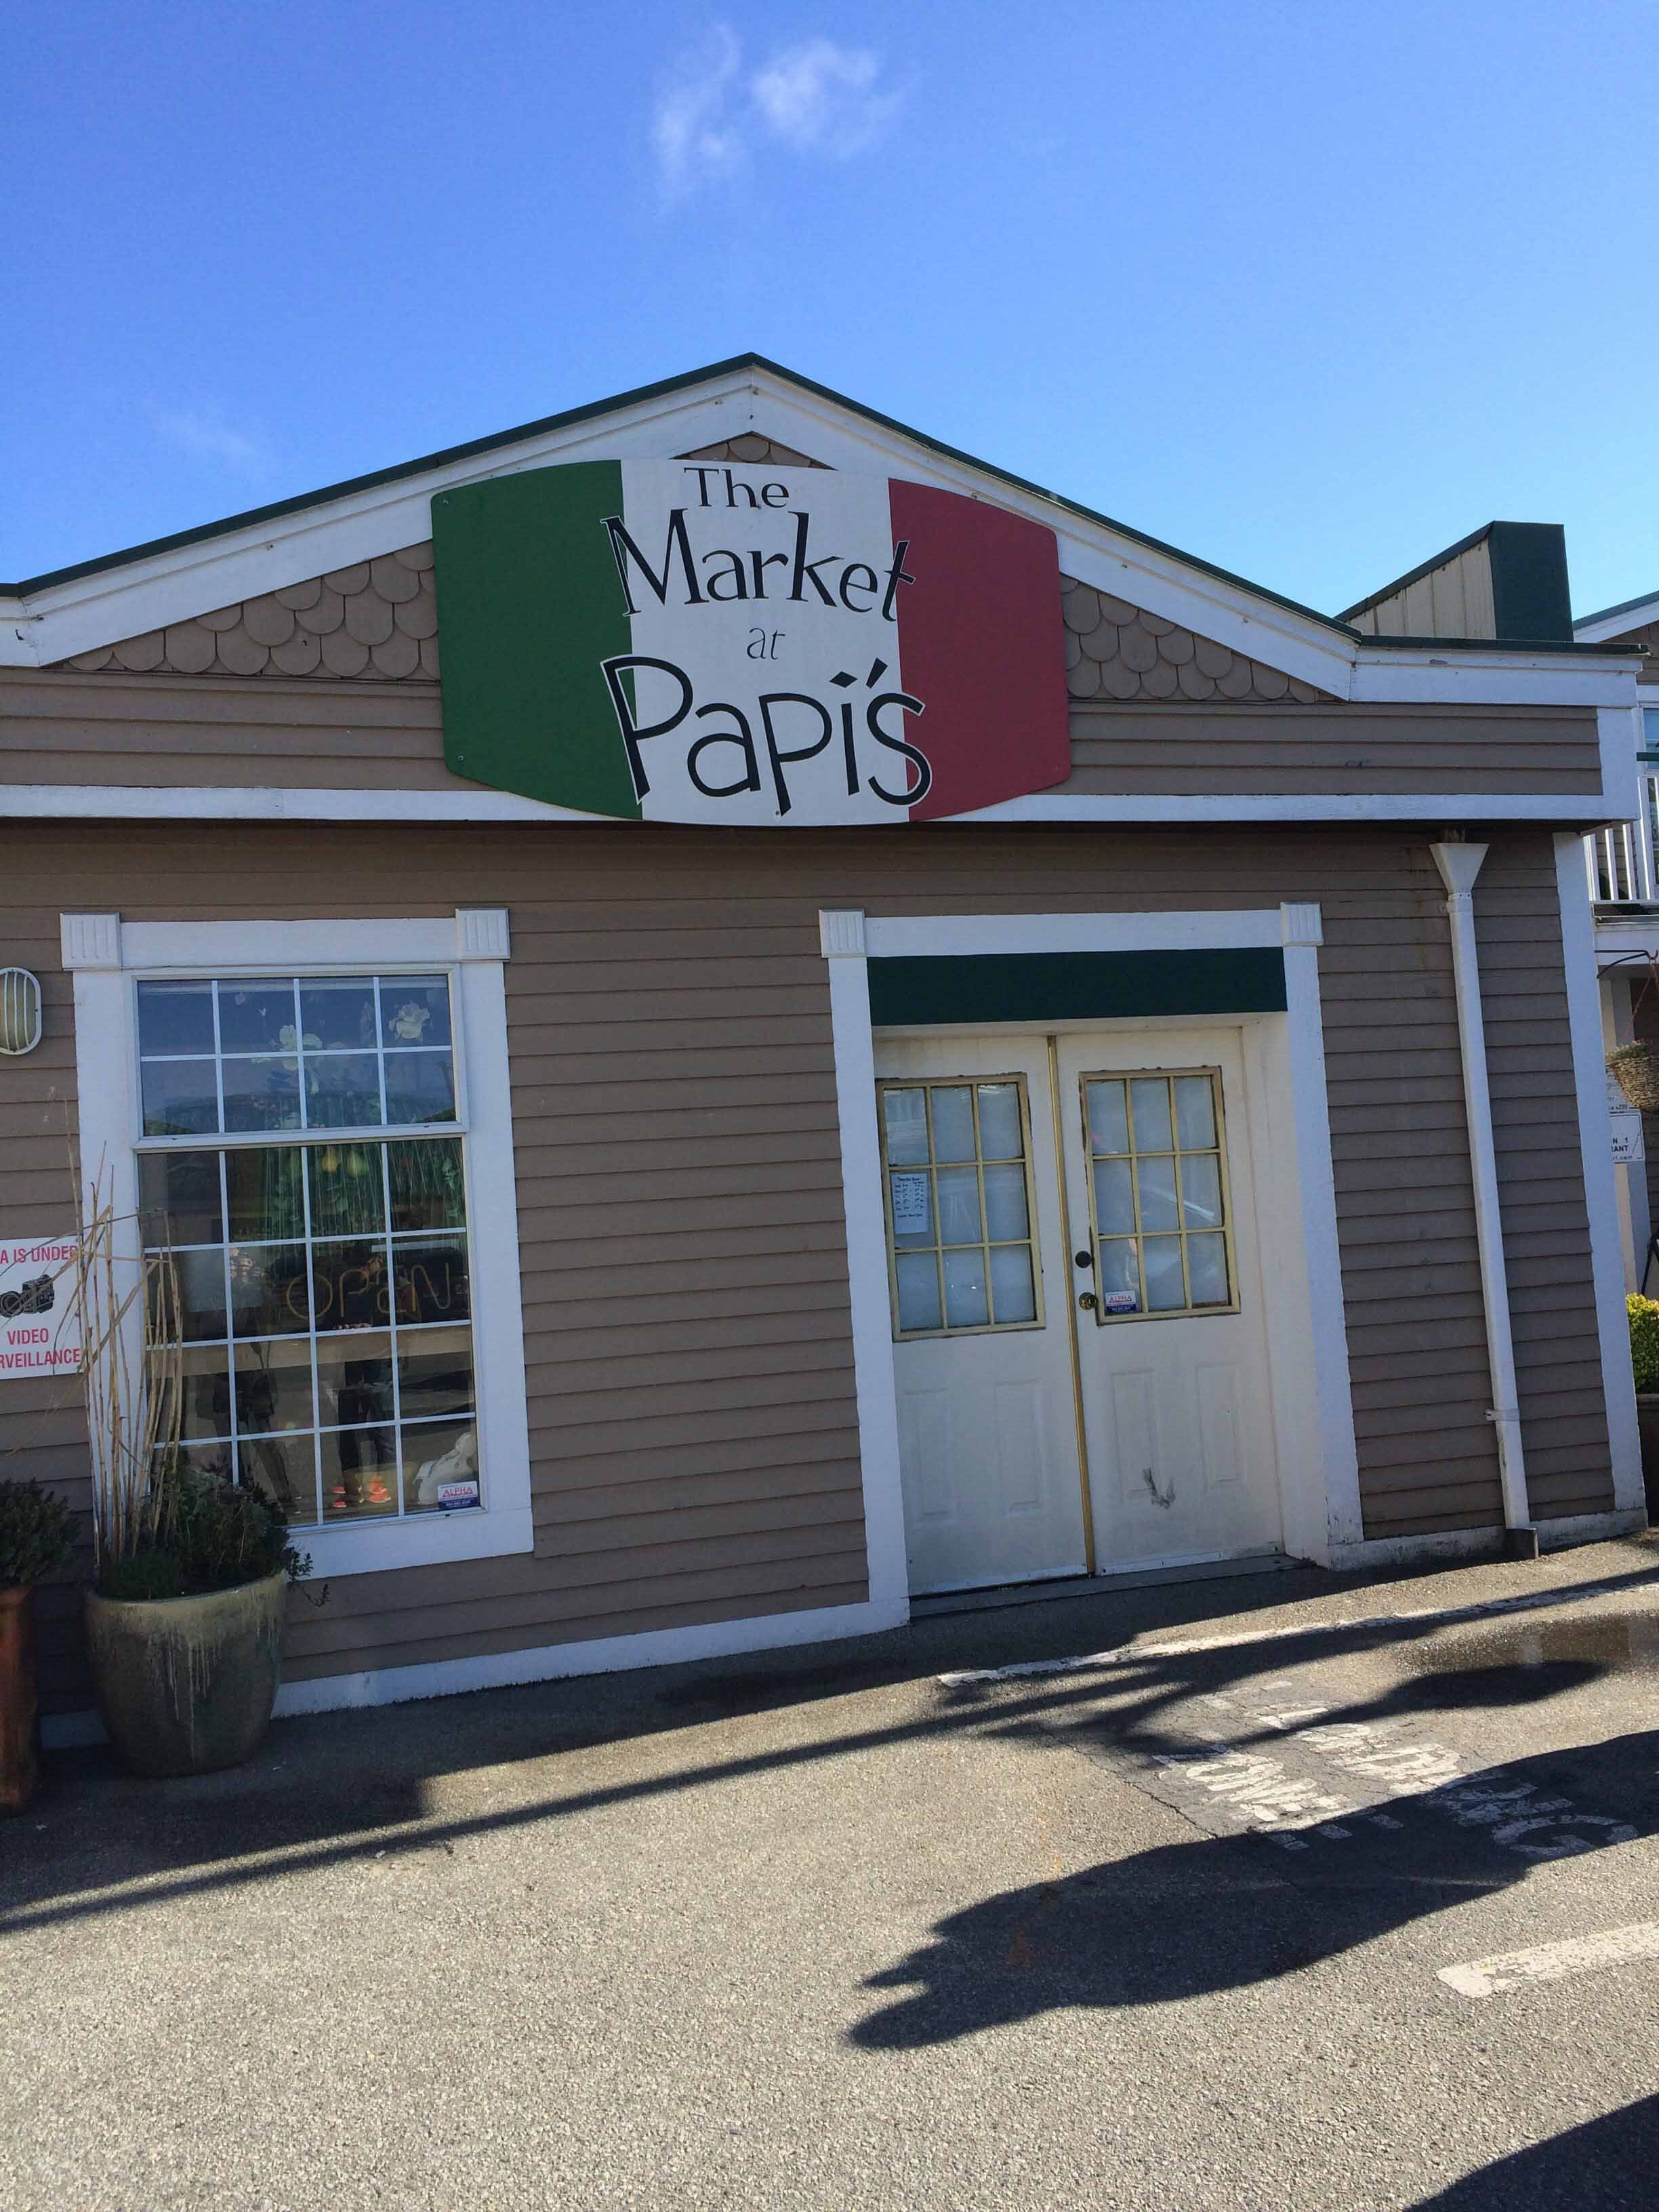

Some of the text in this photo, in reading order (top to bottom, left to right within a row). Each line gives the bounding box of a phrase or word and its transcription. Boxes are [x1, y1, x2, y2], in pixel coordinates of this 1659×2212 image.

[684, 468, 790, 508] The
[600, 508, 916, 621] Market
[746, 628, 785, 660] at
[600, 654, 932, 817] Papi's
[14, 1248, 26, 1264] IS
[285, 1262, 452, 1319] OPEN
[7, 1328, 49, 1345] VIDEO
[443, 1486, 473, 1497] ALPHA
